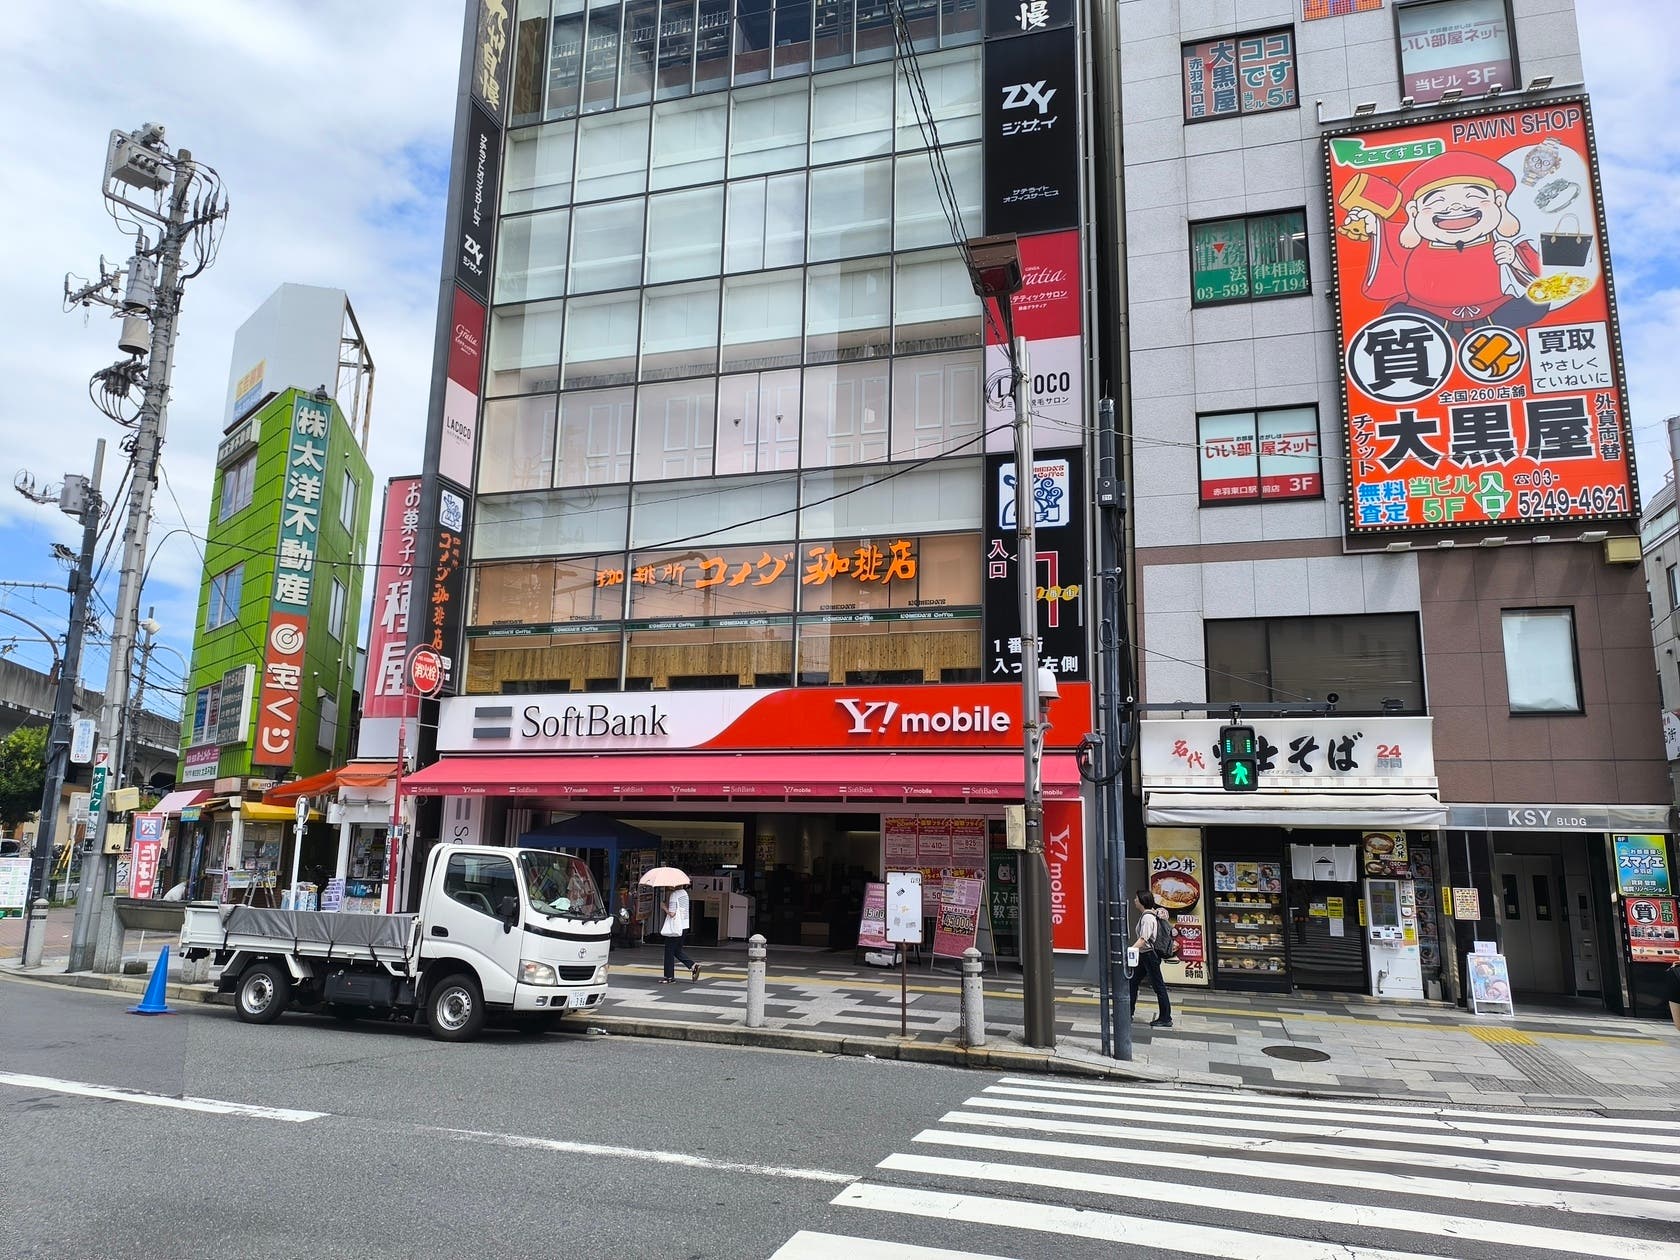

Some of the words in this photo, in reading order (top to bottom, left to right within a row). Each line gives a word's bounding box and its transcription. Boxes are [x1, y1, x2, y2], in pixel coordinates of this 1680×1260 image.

[1210, 41, 1238, 113] 大黒屋
[1415, 73, 1462, 91] 当ビル
[1467, 66, 1497, 85] 3F
[1002, 79, 1056, 114] ZXY
[1002, 116, 1057, 136] ジザイ
[1453, 116, 1516, 143] PAWN
[1522, 109, 1581, 134] SHOP
[1354, 149, 1405, 165] ここです
[1413, 142, 1438, 158] 5F
[1022, 267, 1063, 285] ratia
[1229, 259, 1306, 281] 法律相談
[1196, 277, 1307, 300] 03-5939-7194
[1538, 327, 1597, 355] 買取
[1364, 324, 1438, 393] 質
[1540, 356, 1599, 373] やさしく
[997, 371, 1070, 398] LOCO
[1534, 371, 1609, 390] ていねいに
[1439, 386, 1526, 404] 全国260店舗
[446, 415, 472, 440] LACOCO
[1374, 395, 1598, 472] 大黒屋
[1595, 393, 1622, 461] 外貨両替
[1206, 438, 1318, 459] いい部屋ネット
[1352, 413, 1376, 476] チケット
[1213, 484, 1281, 496] 赤羽東口駅前店
[1289, 476, 1313, 492] 3F
[1358, 481, 1407, 503] 無料
[1408, 476, 1476, 498] 当ビル
[1480, 473, 1508, 515] 入口
[1422, 496, 1466, 522] 5F
[1517, 484, 1629, 518] 5249-4621
[1359, 502, 1408, 525] 査定
[399, 482, 421, 578] お菓子の
[696, 551, 794, 588] コメダ
[802, 540, 918, 585] 珈琲店
[987, 539, 1009, 579] 入口
[414, 661, 437, 682] 消火栓
[992, 655, 1079, 675] 入っ左側
[261, 661, 301, 753] 宝くじ
[521, 704, 669, 738] SoftBank
[1171, 739, 1206, 770] 名代
[1212, 731, 1364, 773] 士そば
[1376, 744, 1402, 758] 24
[1376, 758, 1403, 769] 時間
[731, 785, 756, 793] SoftBank
[971, 786, 999, 795] SoftBank
[1508, 809, 1552, 826] KSY
[1556, 817, 1587, 827] BLDG
[1152, 857, 1196, 873] かつ丼
[1619, 855, 1665, 869] スマイエ
[993, 890, 1018, 904] スマホ
[993, 905, 1019, 919] 教室
[1634, 904, 1655, 921] 質
[1661, 901, 1674, 923] 買取
[1185, 961, 1202, 969] 24
[1185, 970, 1203, 978] 時間
